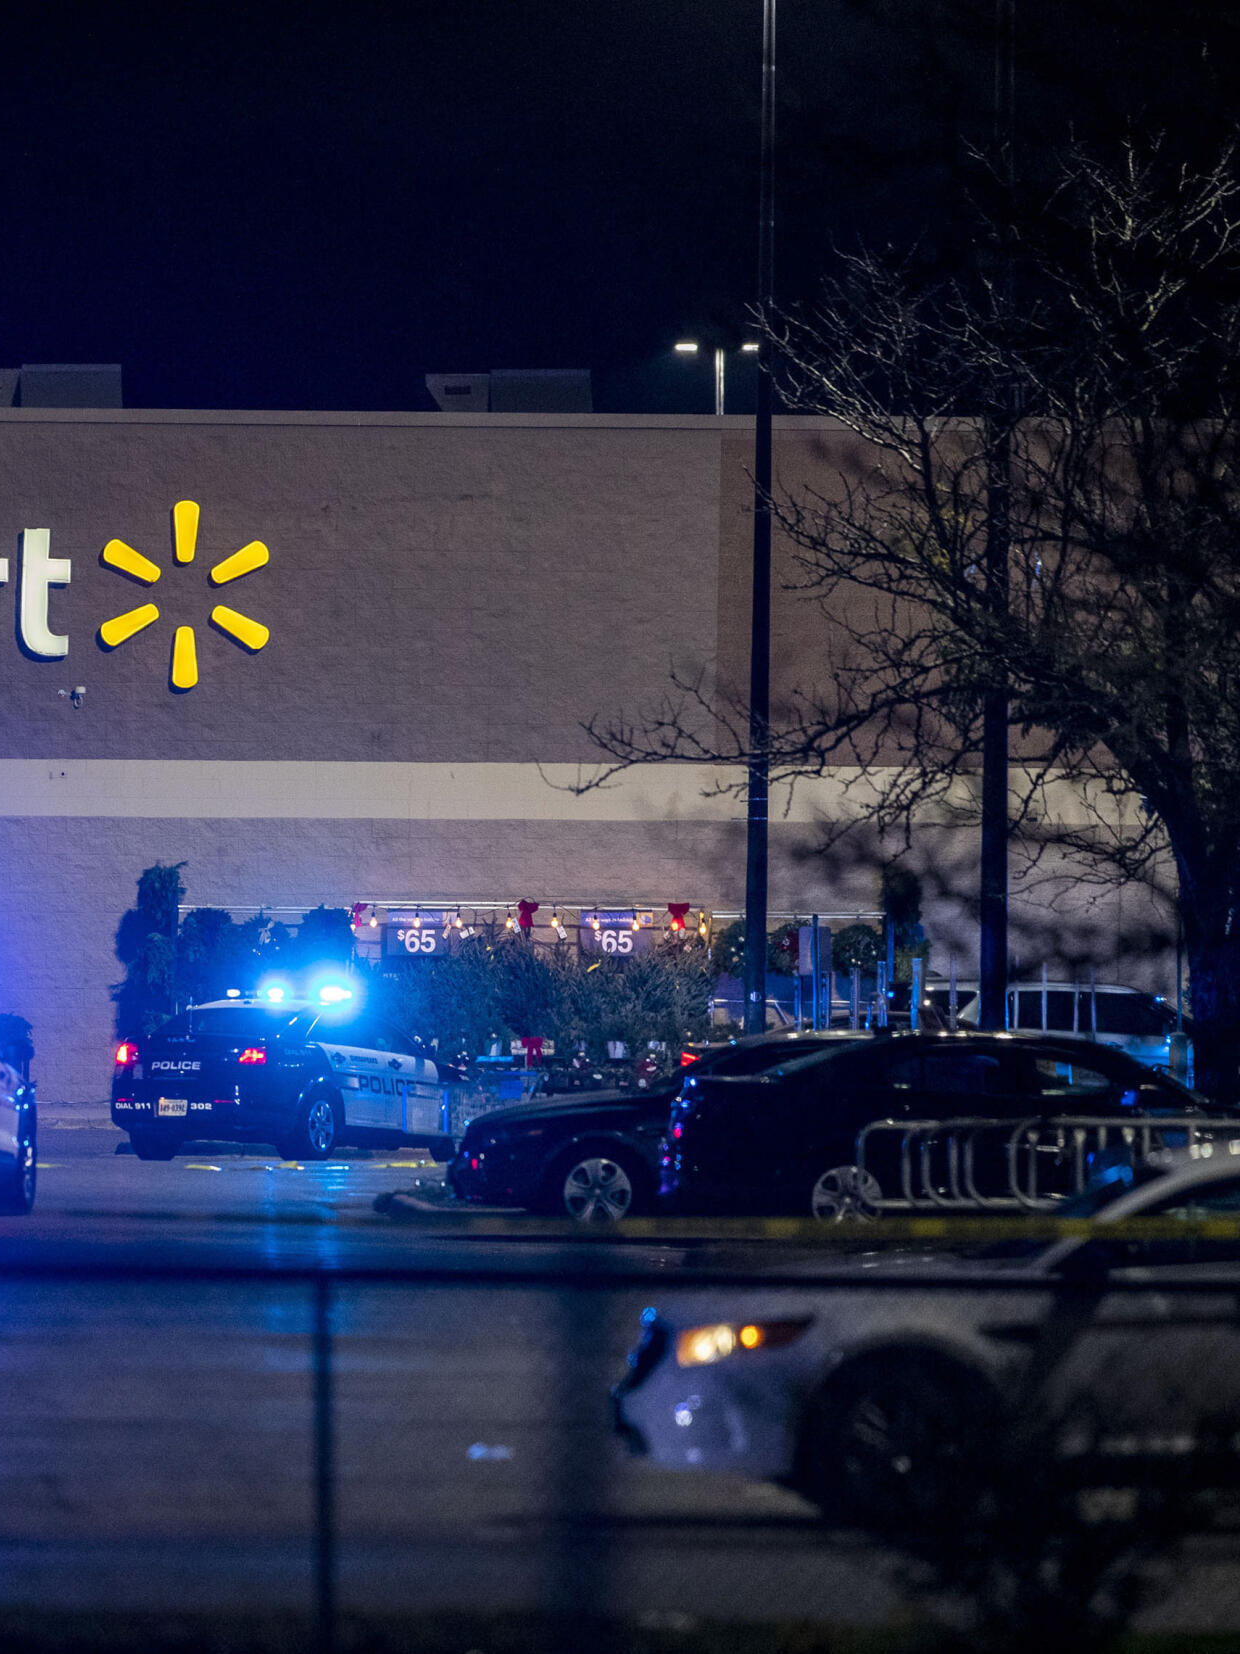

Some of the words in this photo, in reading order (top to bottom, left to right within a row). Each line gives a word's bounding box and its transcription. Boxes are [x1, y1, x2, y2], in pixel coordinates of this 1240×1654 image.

[397, 929, 436, 953] $65
[594, 930, 633, 953] $65
[151, 1061, 201, 1070] POLICE
[190, 1102, 213, 1110] 302
